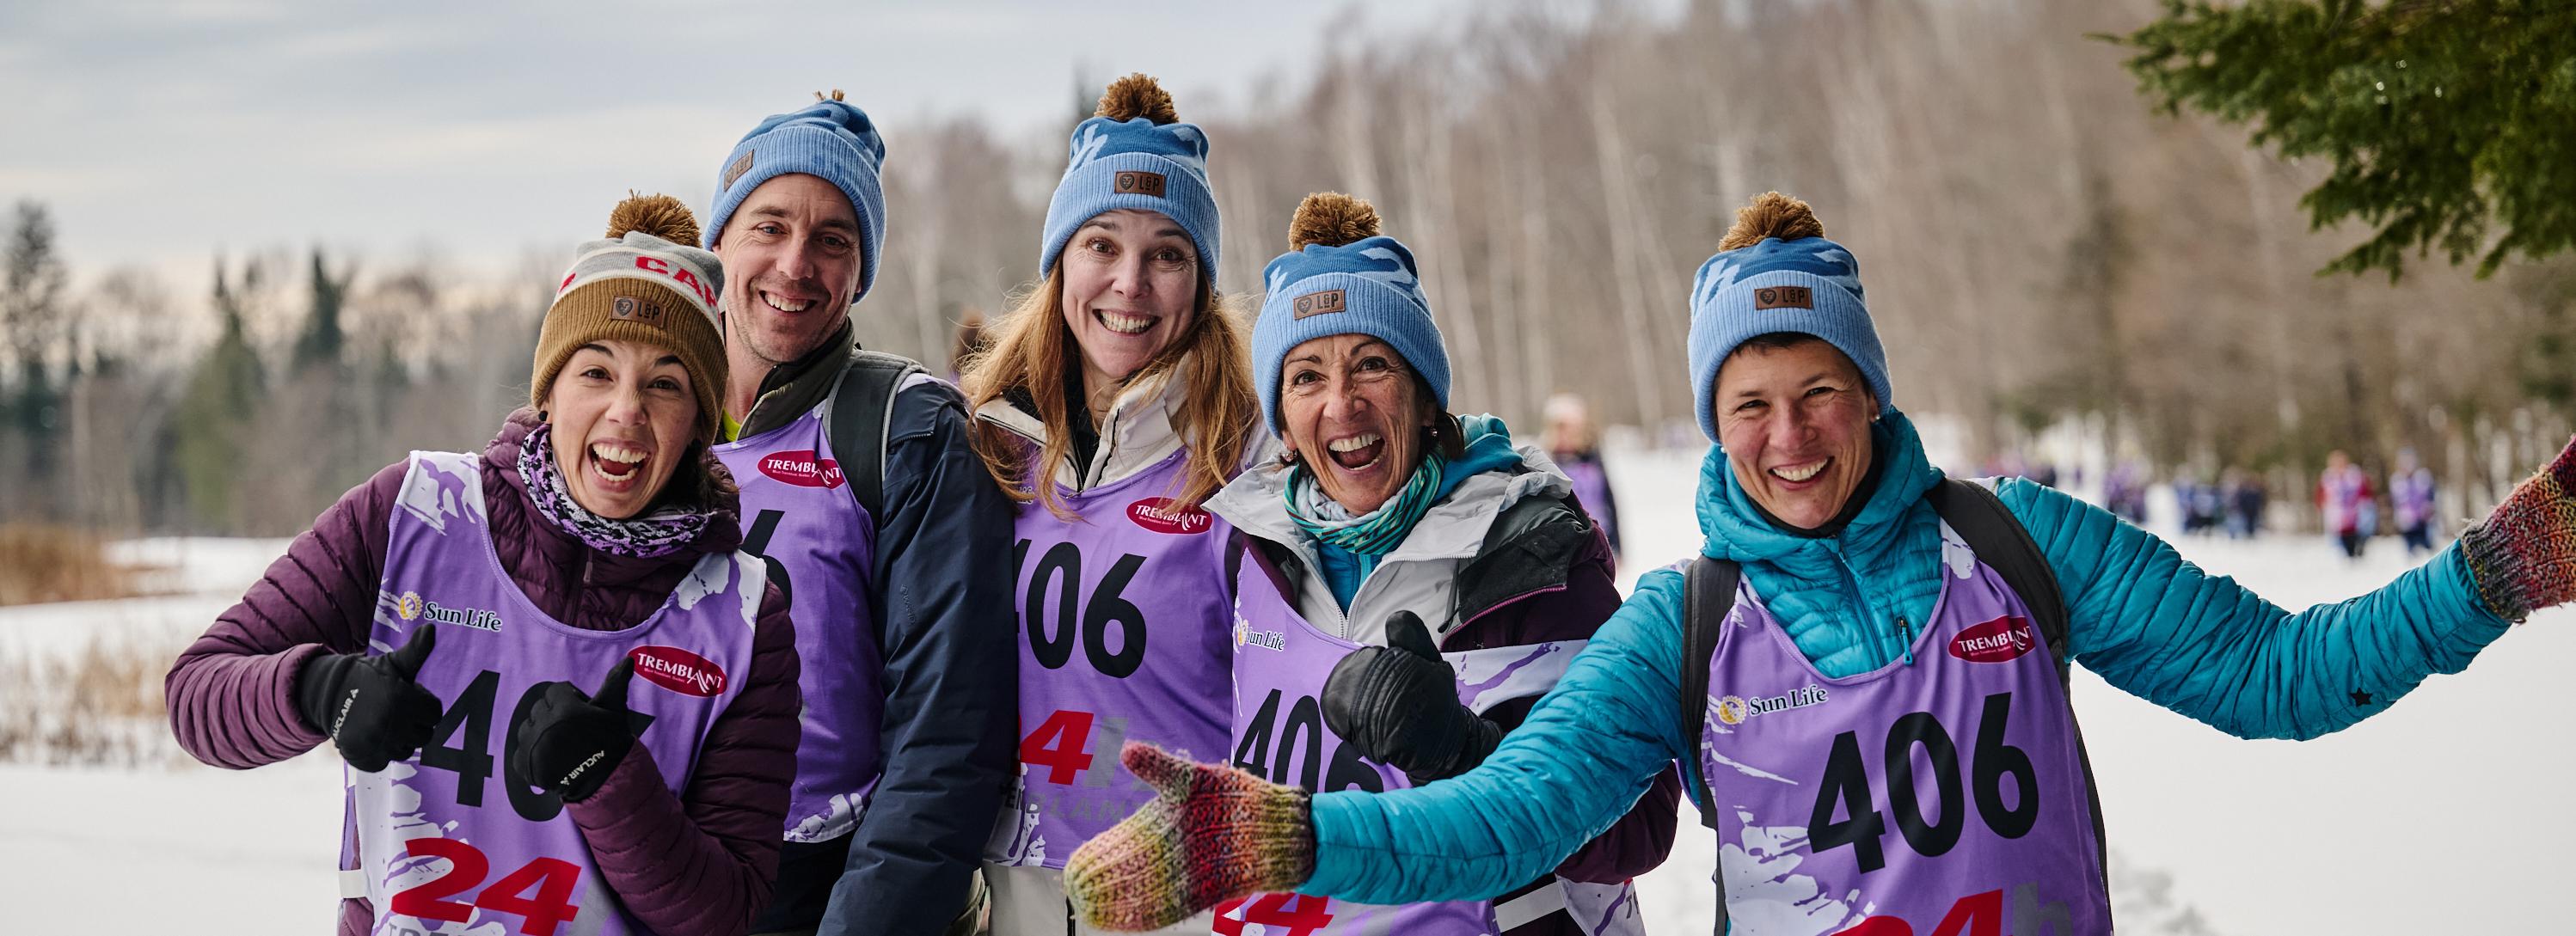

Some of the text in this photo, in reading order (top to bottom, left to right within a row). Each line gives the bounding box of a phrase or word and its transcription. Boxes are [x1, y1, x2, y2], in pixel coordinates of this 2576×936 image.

[1138, 174, 1160, 193] L&P
[636, 301, 660, 320] L&P
[1316, 292, 1339, 310] L&P
[1781, 290, 1806, 303] L&P
[767, 459, 841, 486] TREMBLANT
[425, 602, 502, 632] Sun Life
[1015, 538, 1148, 679] 06
[1263, 629, 1285, 652] Life
[637, 652, 723, 694] TREMBLANT
[1749, 685, 1827, 716] Sun Life
[568, 750, 604, 780] AUCLAIR
[1807, 692, 2039, 874] 406
